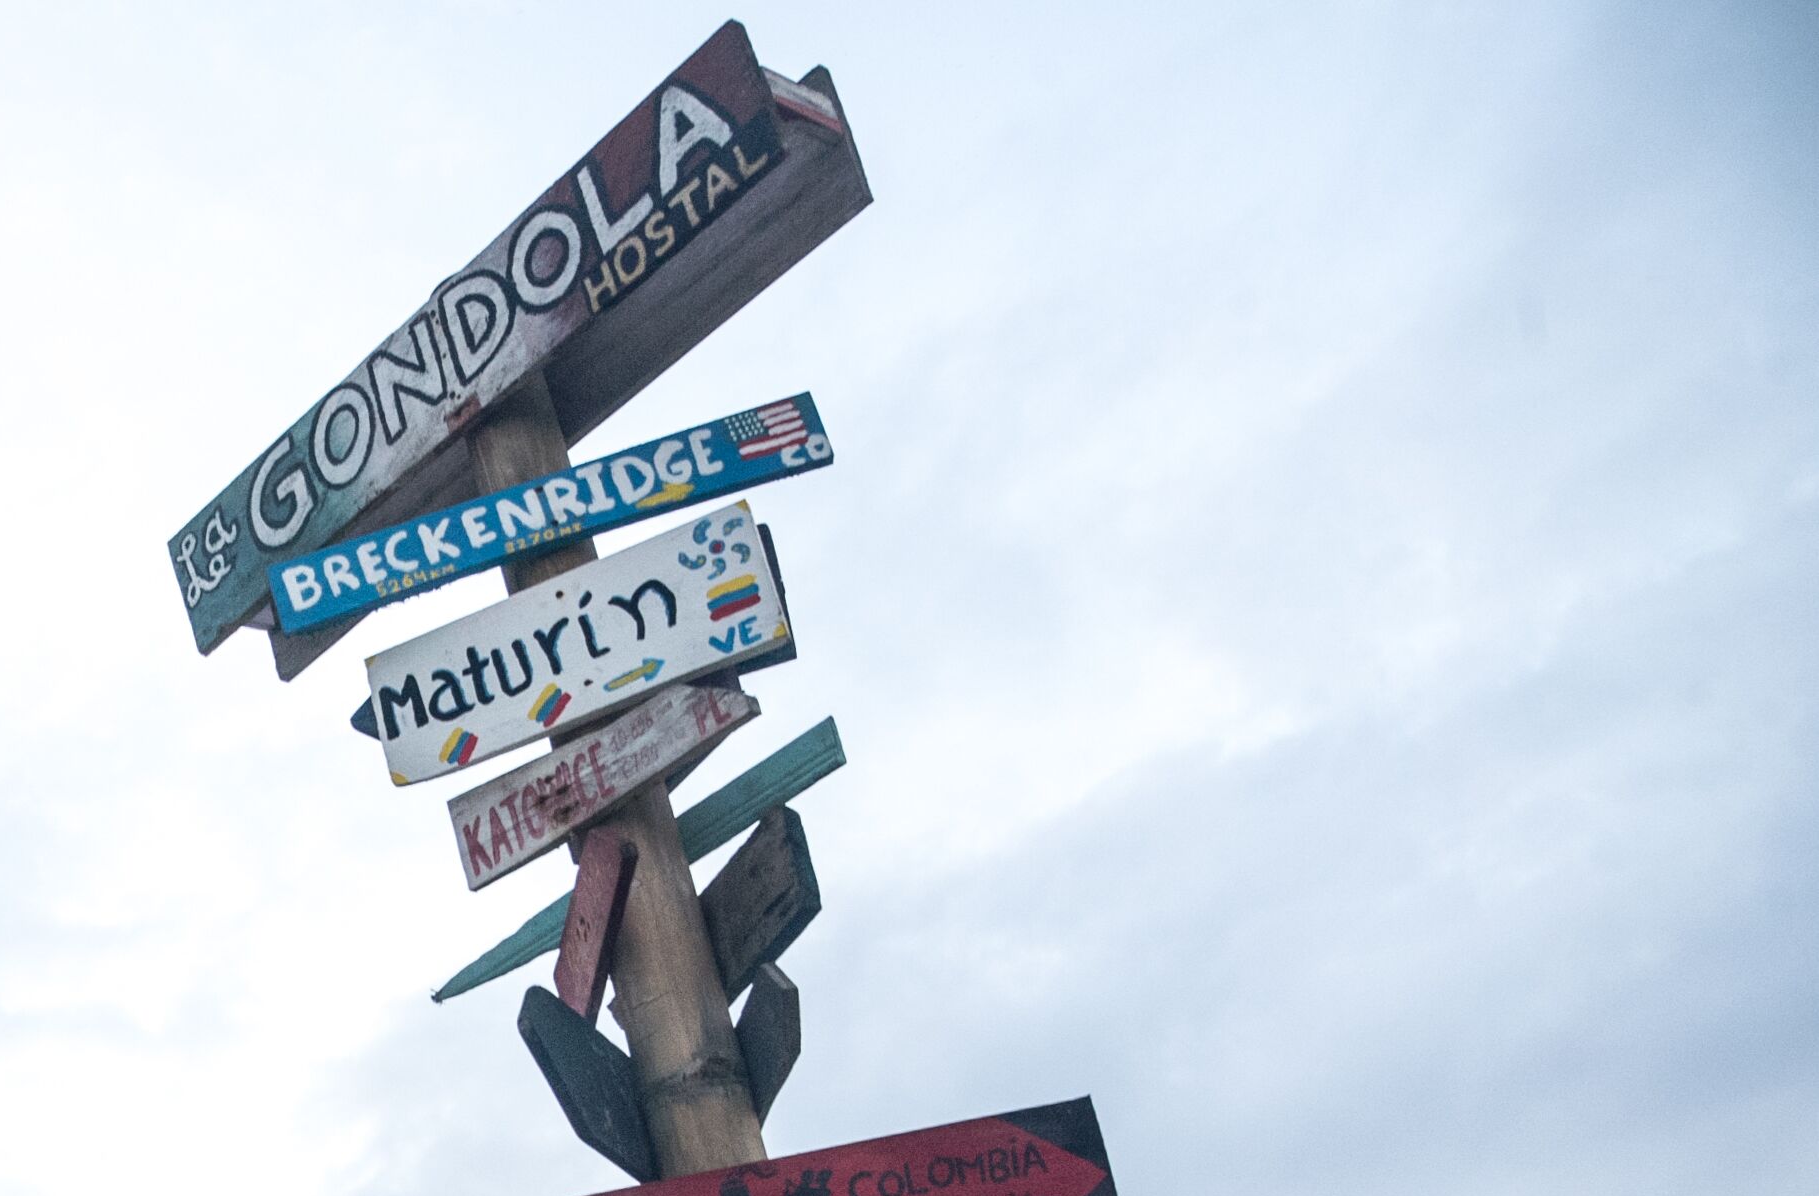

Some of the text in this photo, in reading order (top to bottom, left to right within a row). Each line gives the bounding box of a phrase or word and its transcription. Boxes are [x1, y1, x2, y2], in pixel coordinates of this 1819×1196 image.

[582, 145, 769, 313] HOSTAL
[247, 81, 735, 549] GONDOLA
[282, 428, 724, 616] BRECKENRIDGE
[781, 433, 831, 467] CO
[709, 616, 762, 654] VE
